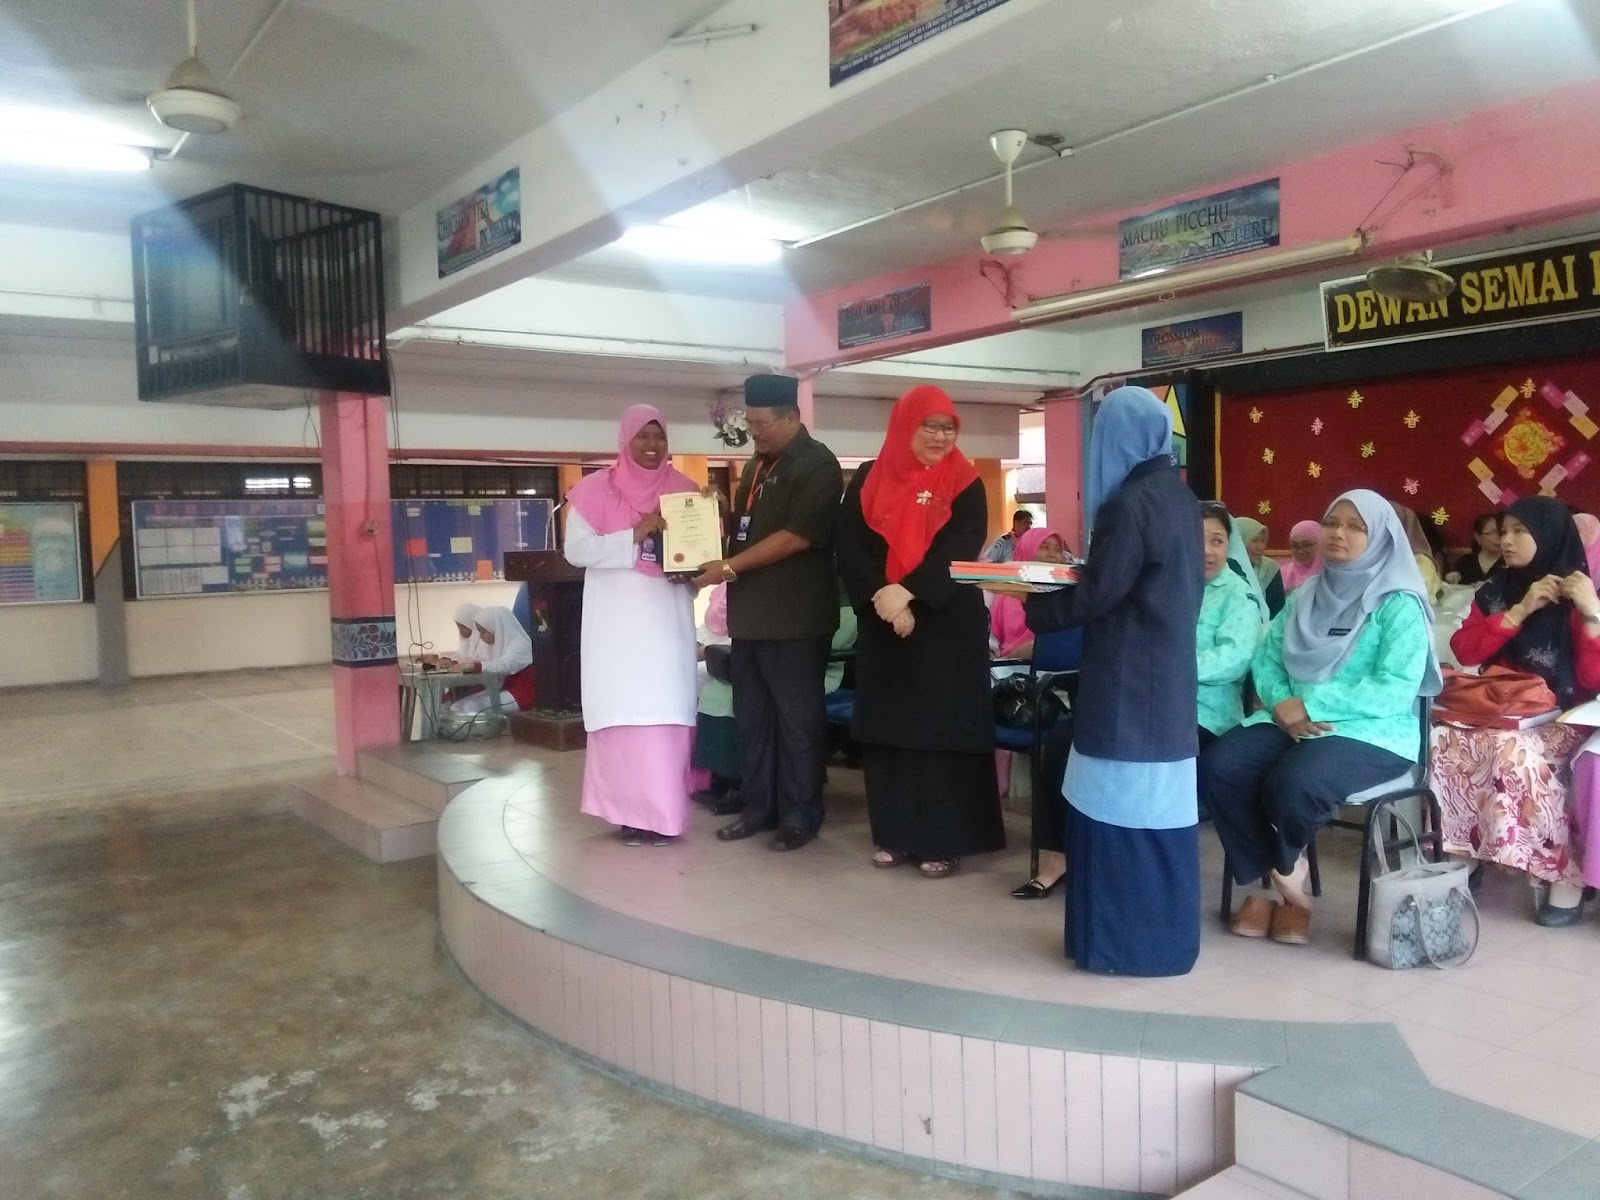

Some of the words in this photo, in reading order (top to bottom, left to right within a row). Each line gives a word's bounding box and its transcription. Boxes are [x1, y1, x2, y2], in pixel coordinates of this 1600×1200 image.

[1122, 218, 1169, 248] MACHU
[1175, 203, 1230, 234] PICCHU
[1211, 230, 1228, 247] IN
[1234, 218, 1274, 242] PERU
[1460, 255, 1579, 315] SEMAI
